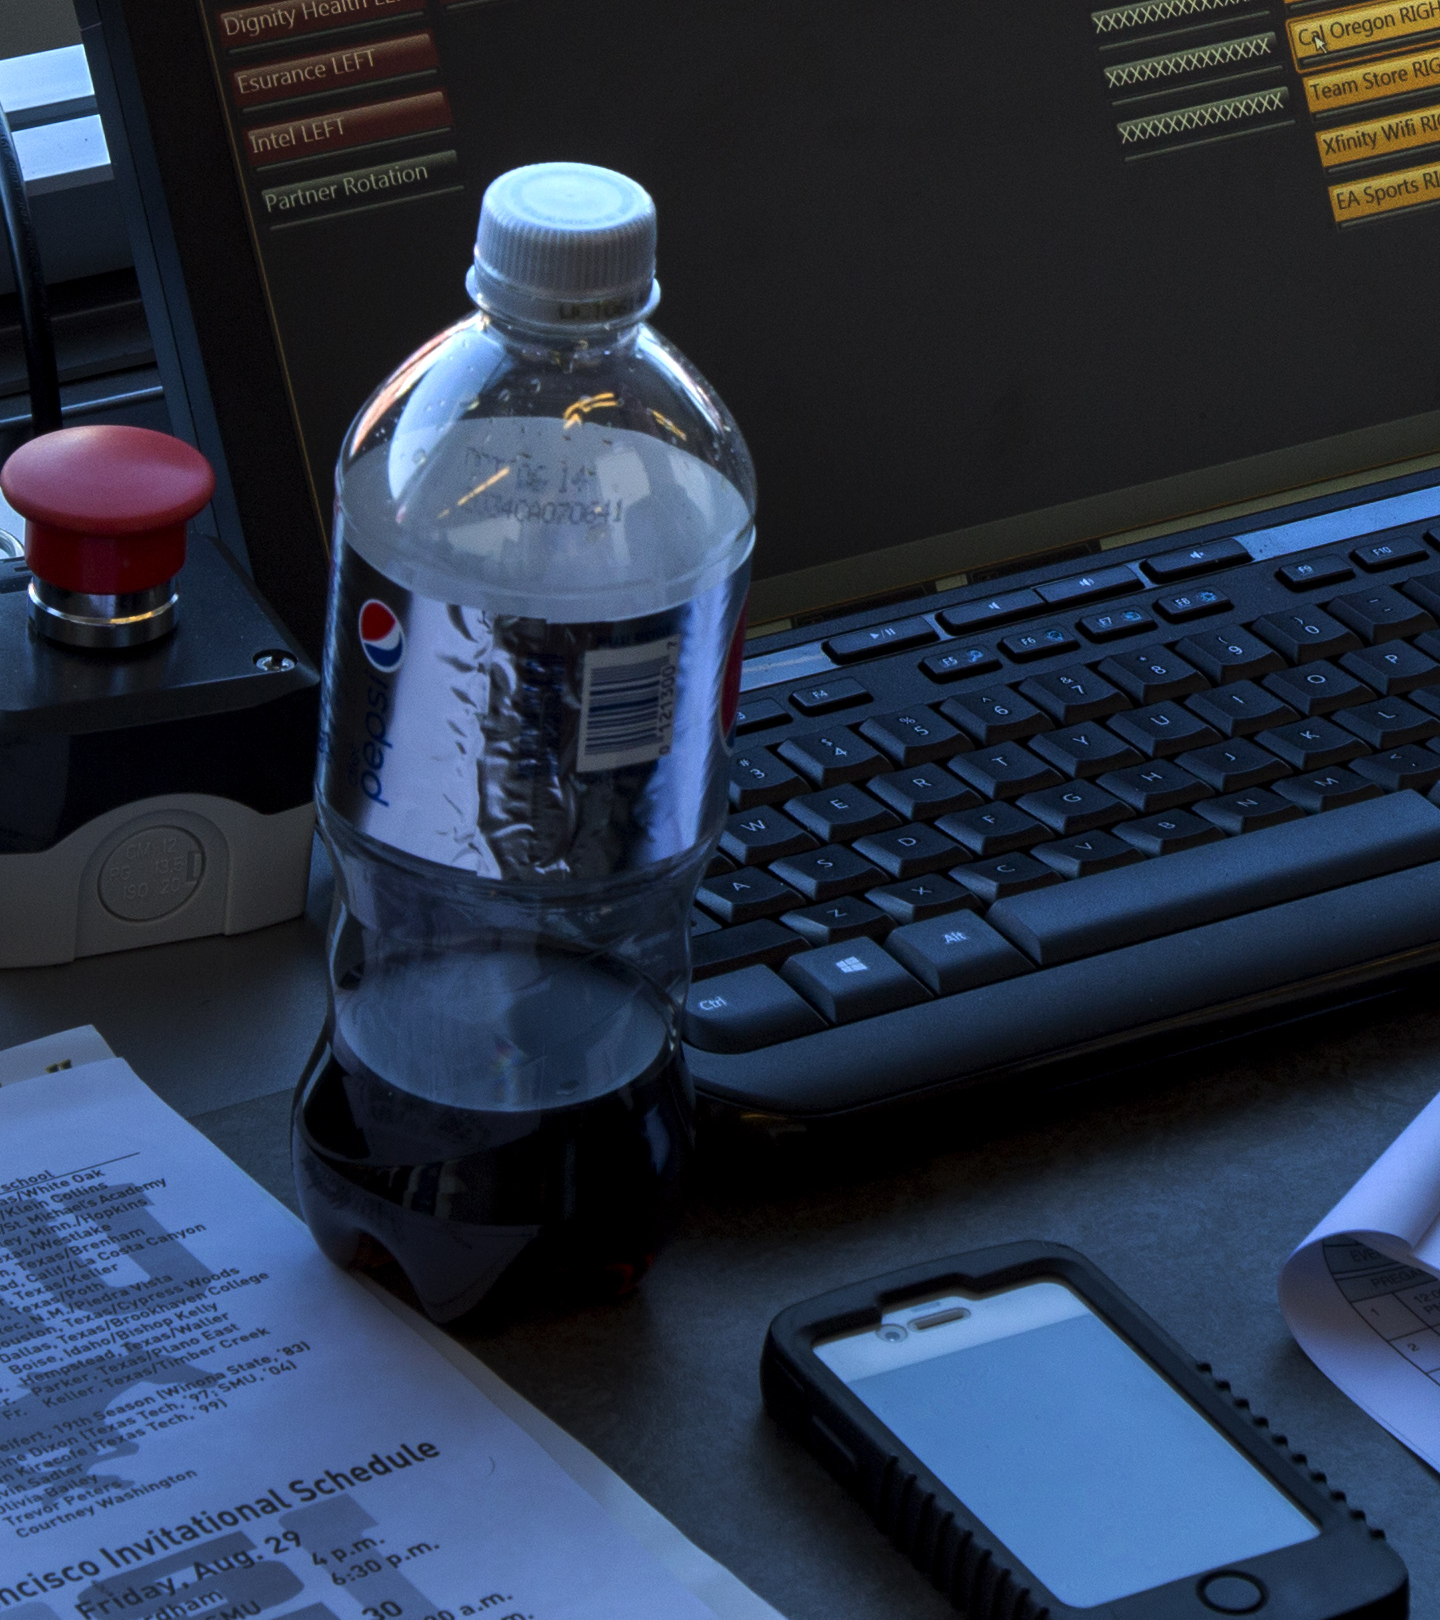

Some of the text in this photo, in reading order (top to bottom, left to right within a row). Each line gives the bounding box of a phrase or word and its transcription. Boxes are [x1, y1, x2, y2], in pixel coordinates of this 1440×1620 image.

[221, 2, 300, 41] Dignity
[235, 48, 378, 95] Esurance LEFT
[1310, 75, 1360, 103] Team
[1360, 63, 1410, 92] Store
[248, 115, 348, 154] Intel LEFT
[263, 160, 430, 213] Partner Rotation
[1335, 188, 1361, 211] EA
[1361, 174, 1422, 209] Sports
[357, 667, 393, 807] pepsi
[4, 1481, 123, 1528] Trevor Peters
[16, 1469, 197, 1539] Courtney Washington
[95, 1489, 292, 1569] Invitational
[291, 1438, 440, 1504] Schedule
[76, 1529, 303, 1620] Friday, Aug. 29
[311, 1535, 386, 1568] 4 p.m.
[331, 1540, 440, 1588] 6:30 p.m.
